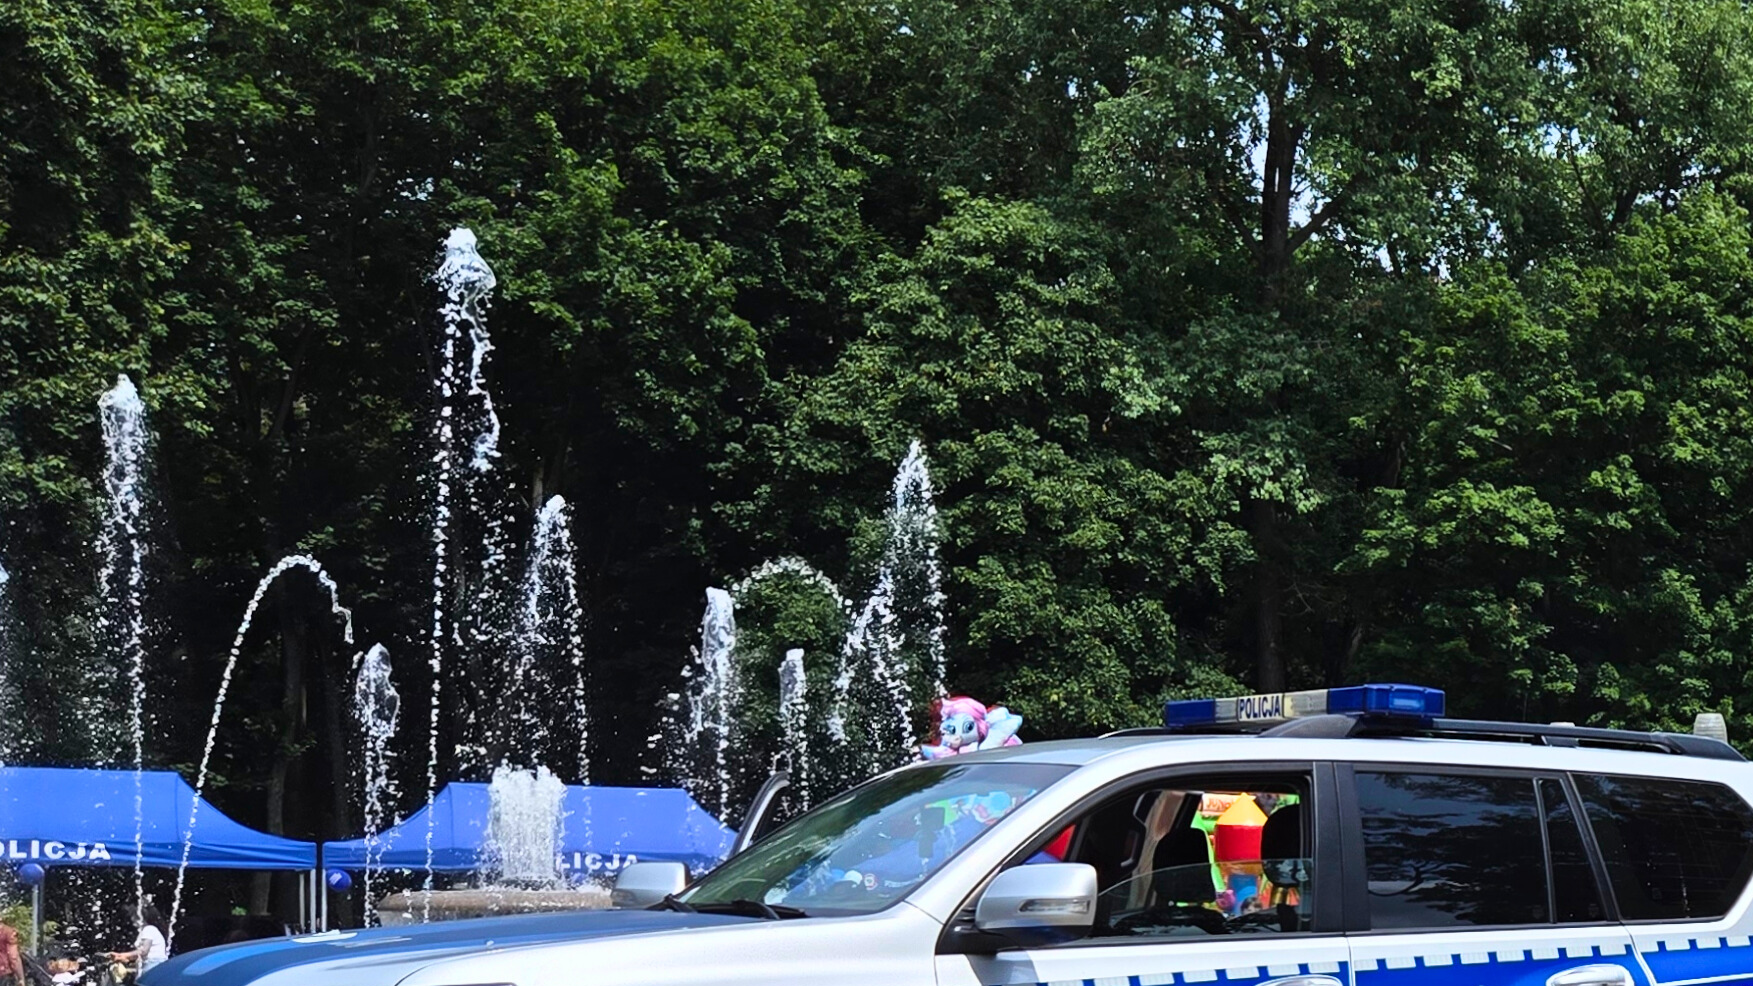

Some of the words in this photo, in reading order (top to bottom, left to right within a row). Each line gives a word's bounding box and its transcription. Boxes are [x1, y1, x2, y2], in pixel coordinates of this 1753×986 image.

[1239, 696, 1281, 719] POLICJA
[0, 840, 111, 860] LICJA
[556, 851, 638, 870] LICJA
